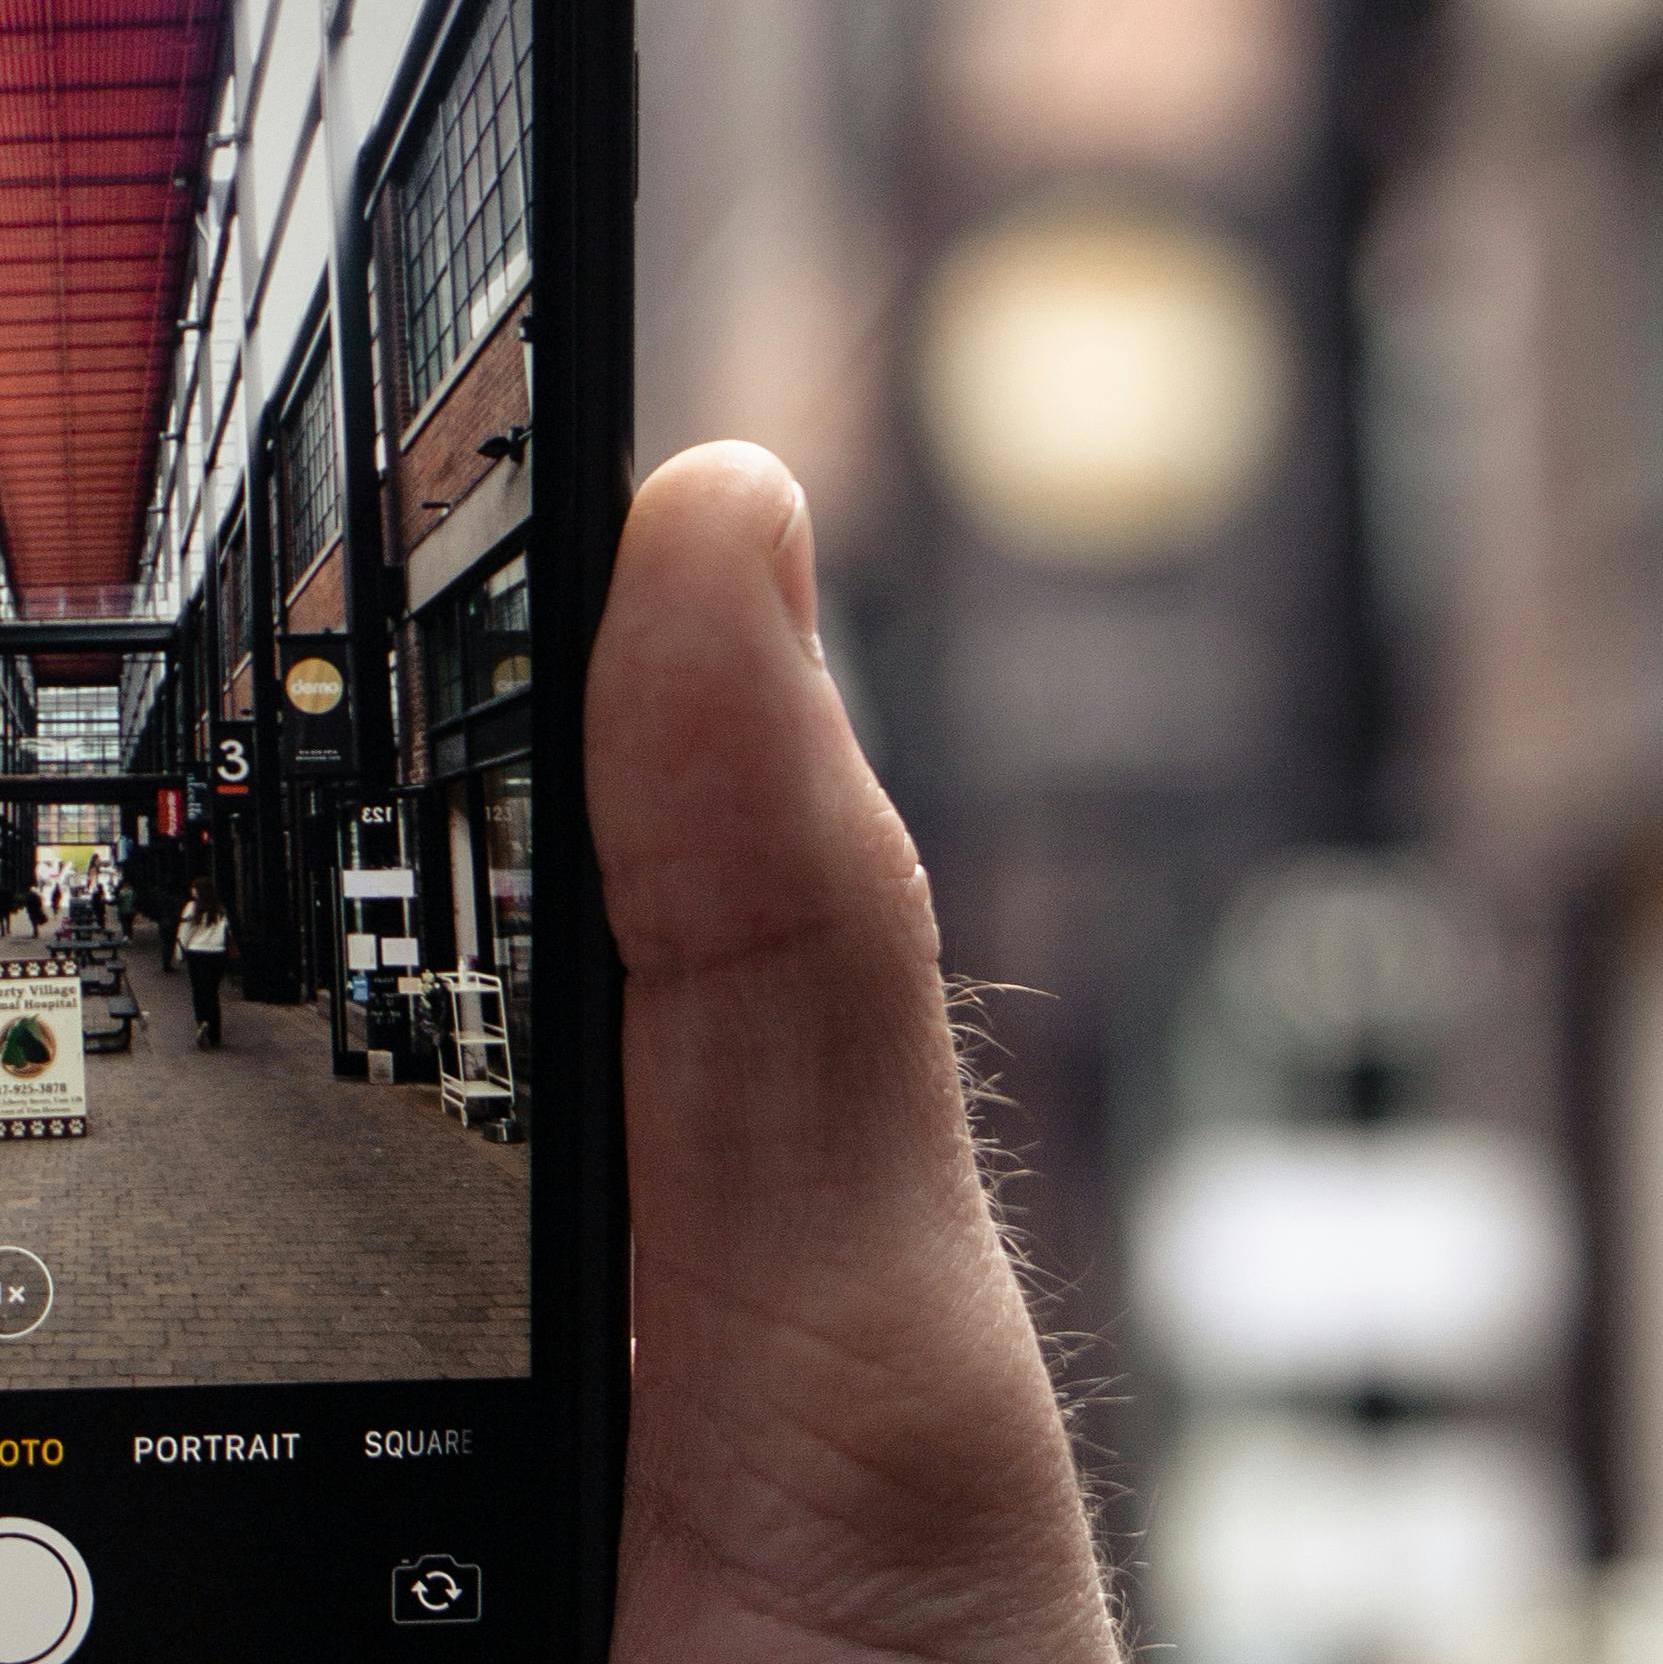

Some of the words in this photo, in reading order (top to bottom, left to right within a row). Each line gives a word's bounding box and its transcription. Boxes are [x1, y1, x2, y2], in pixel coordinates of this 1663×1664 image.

[291, 677, 340, 696] demo
[217, 738, 250, 783] 3
[29, 984, 77, 998] Village
[24, 997, 78, 1011] Hospital
[133, 1432, 301, 1464] PORTRAIT
[363, 1427, 474, 1459] SQUARE
